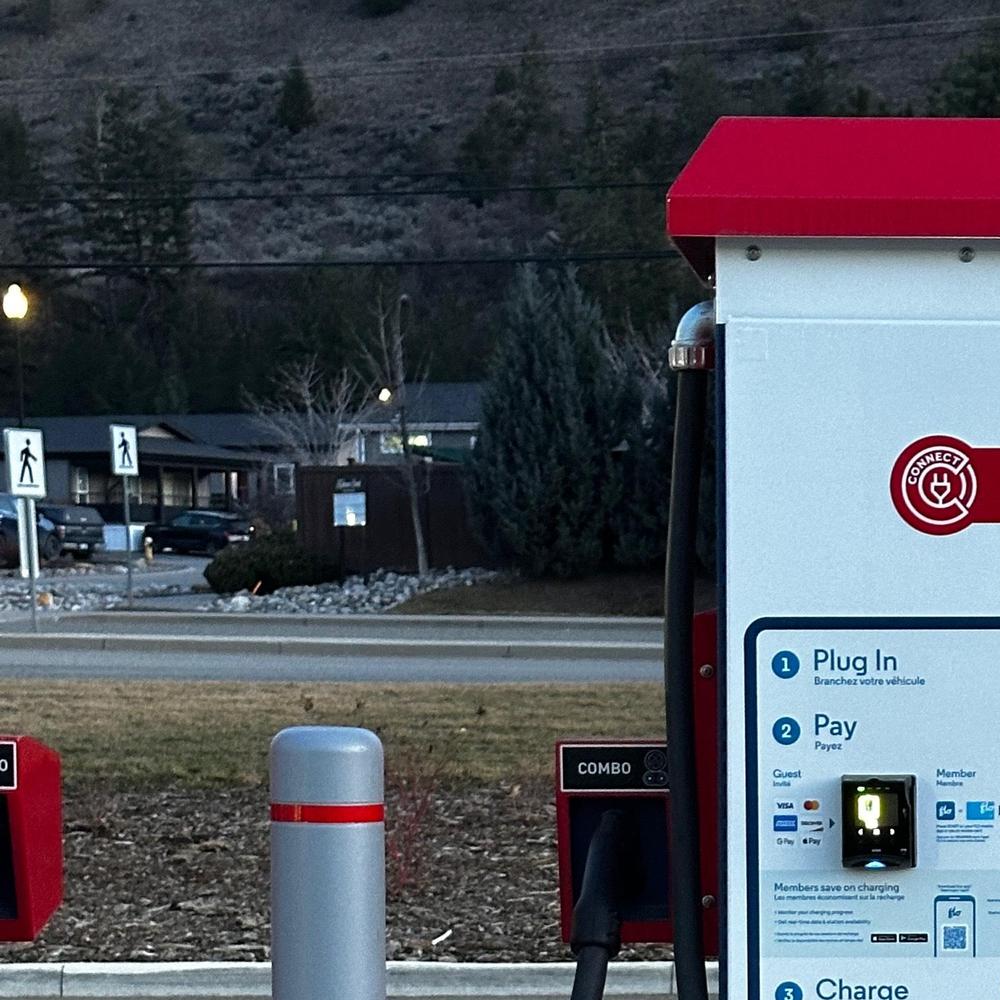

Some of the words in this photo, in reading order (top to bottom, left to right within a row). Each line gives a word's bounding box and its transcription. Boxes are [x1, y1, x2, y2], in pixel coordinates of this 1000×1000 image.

[908, 452, 961, 485] CONNECT
[781, 657, 791, 672] 1
[814, 649, 867, 676] Plug
[876, 649, 897, 671] In
[814, 677, 858, 686] Branchez
[860, 678, 884, 686] votre
[886, 677, 925, 686] véhicule
[781, 724, 791, 738] 2
[814, 714, 857, 740] Pay
[814, 741, 842, 752] Payez
[577, 762, 632, 775] COMBO
[773, 769, 802, 778] Guest
[936, 769, 976, 778] Member
[809, 837, 821, 846] Pay
[774, 883, 819, 892] Members
[857, 883, 900, 893] charging
